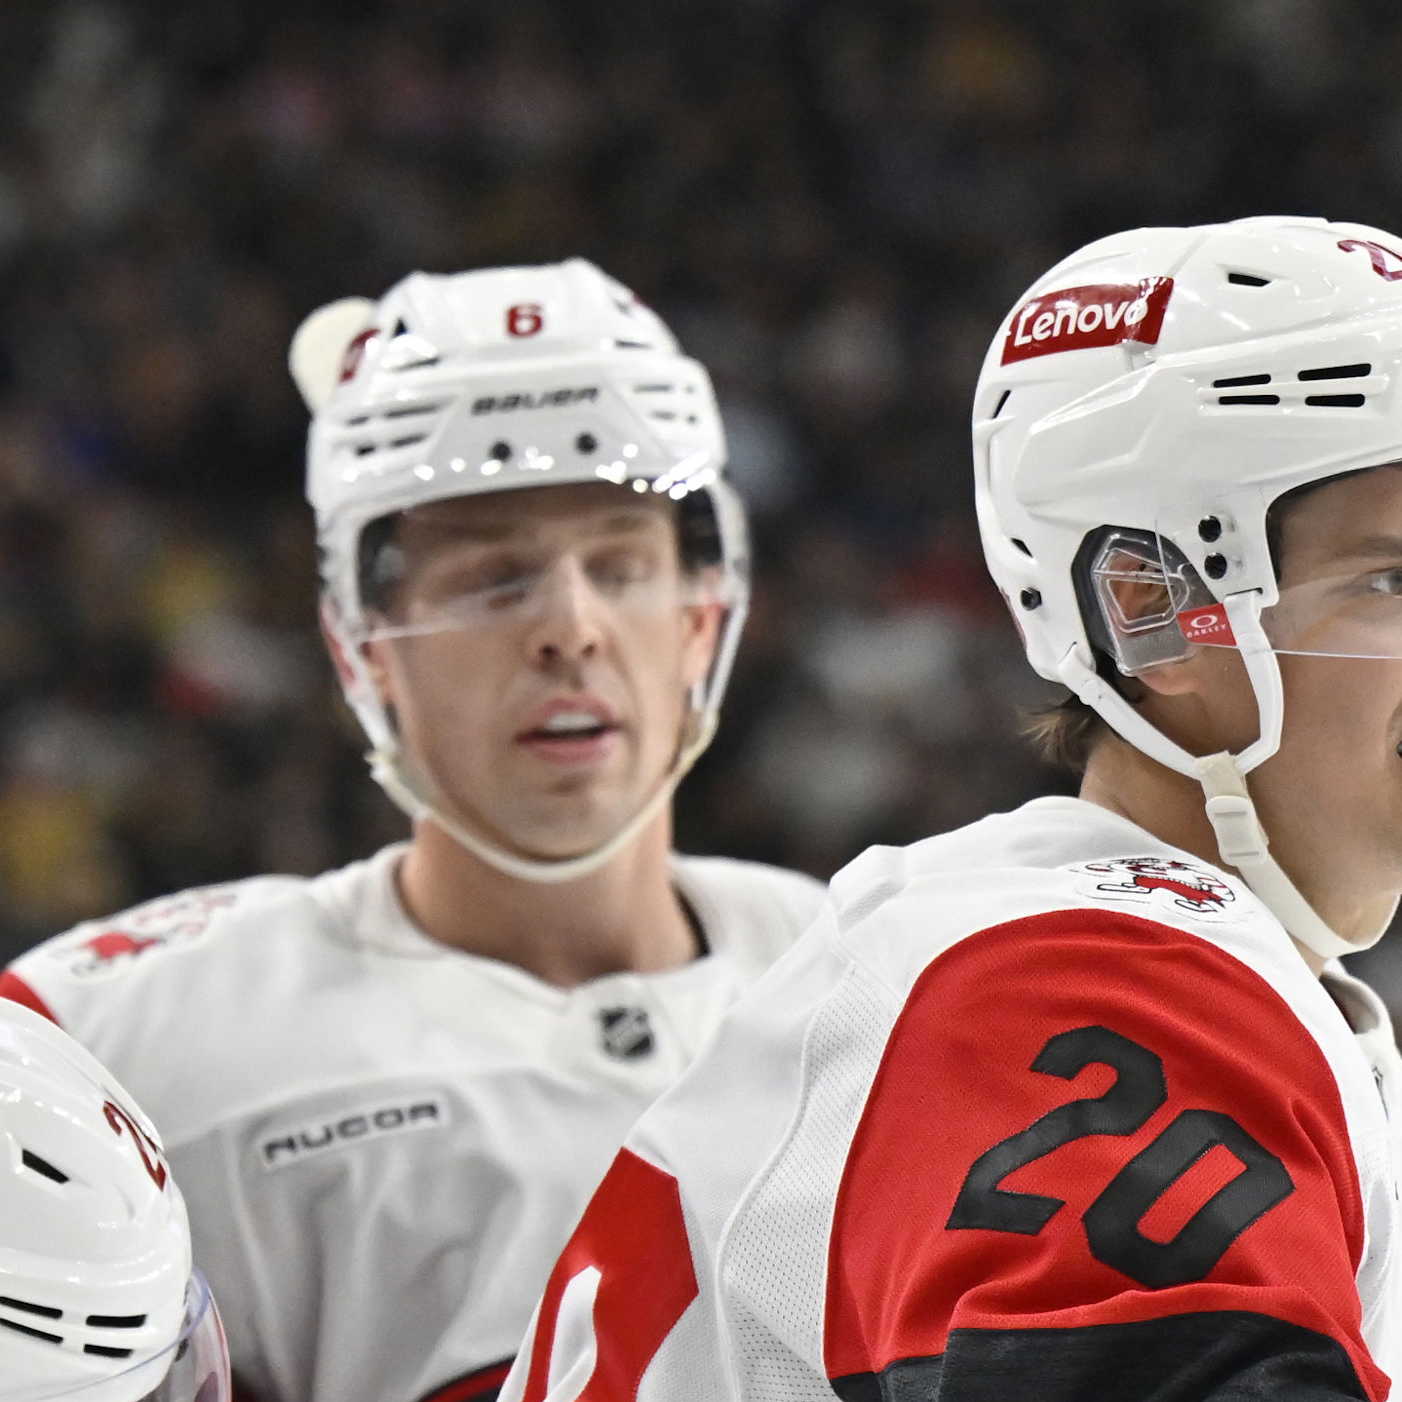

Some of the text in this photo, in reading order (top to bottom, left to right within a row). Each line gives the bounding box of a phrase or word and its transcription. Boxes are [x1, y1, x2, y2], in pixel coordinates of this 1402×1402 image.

[507, 303, 545, 339] 6
[1013, 299, 1149, 346] Lenovo
[1186, 623, 1227, 639] OAKLEY
[263, 1101, 439, 1164] NUCOR
[945, 1025, 1295, 1288] 20
